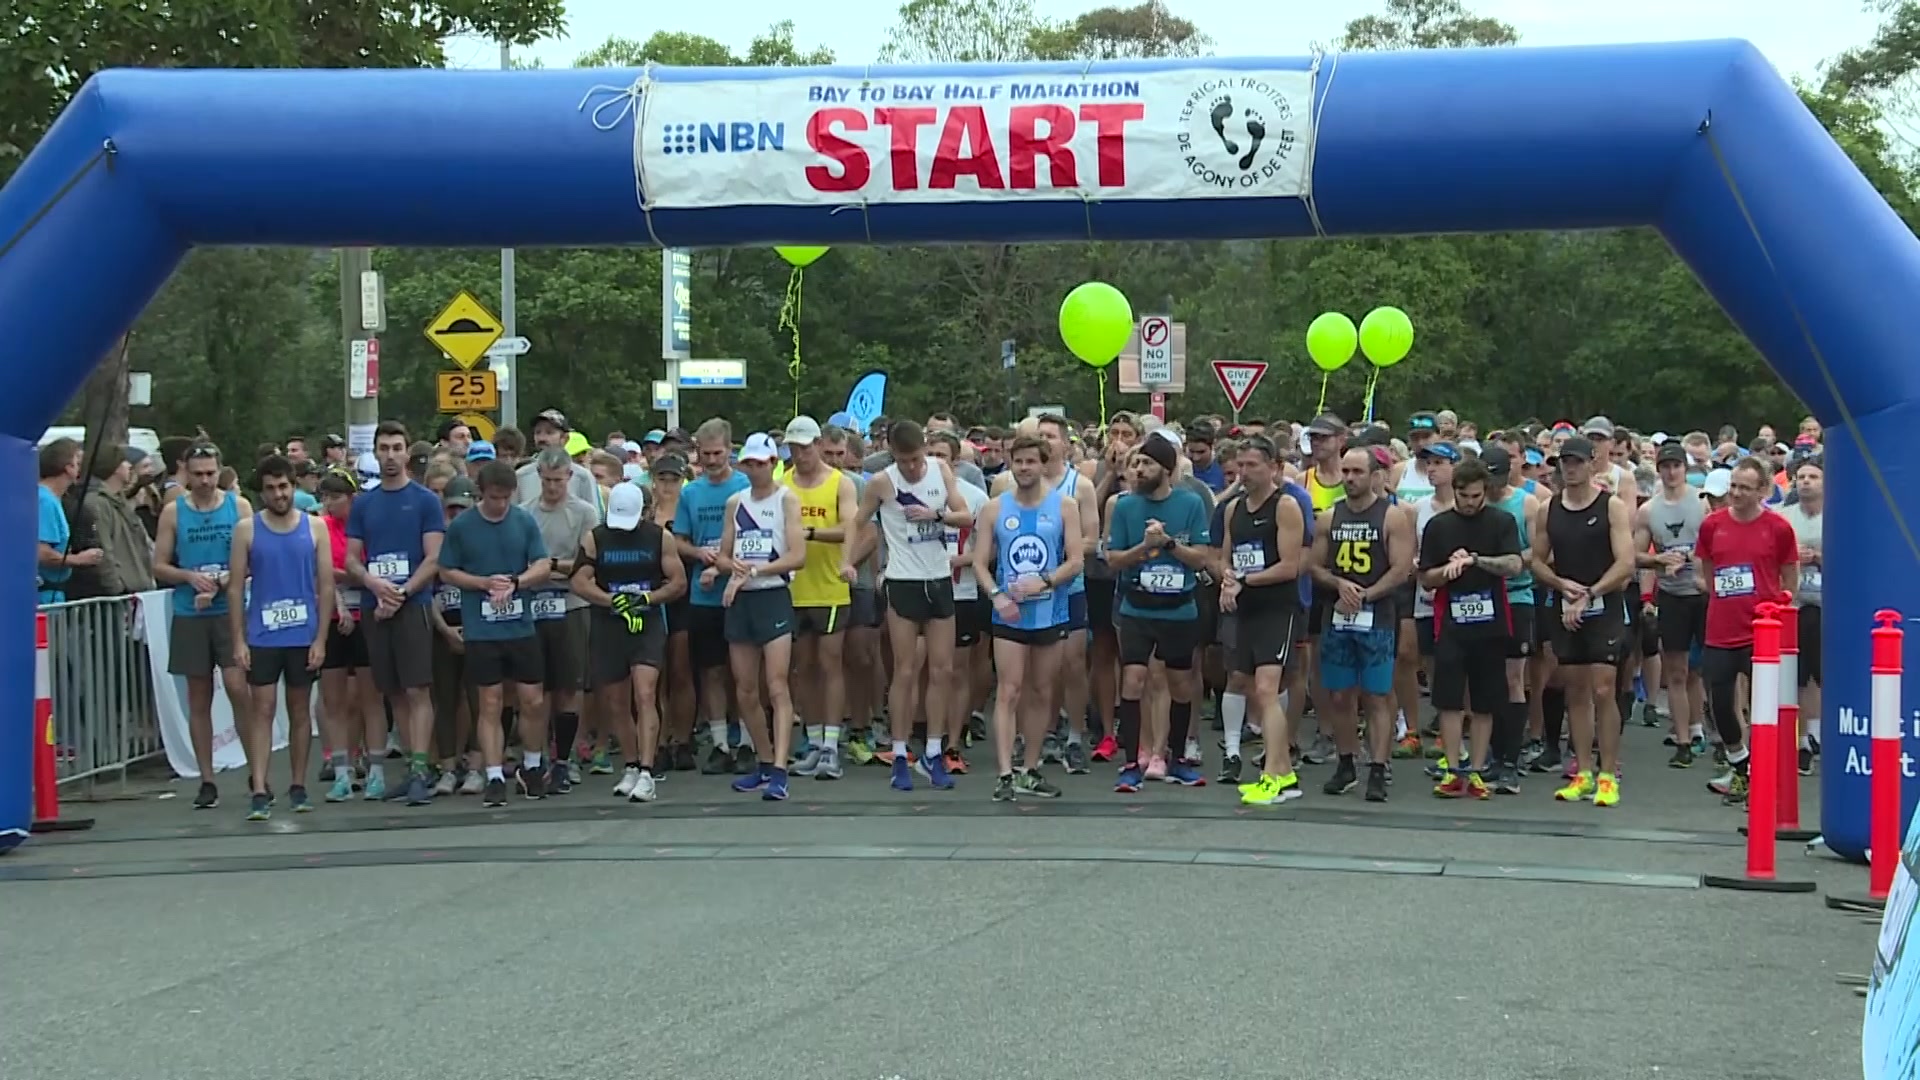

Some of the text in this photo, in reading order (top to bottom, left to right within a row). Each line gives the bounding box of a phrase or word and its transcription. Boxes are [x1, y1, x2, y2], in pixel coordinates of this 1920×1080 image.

[808, 85, 850, 102] BAY
[892, 83, 936, 100] BAY
[944, 83, 1002, 100] HALF
[1010, 81, 1140, 99] MARATHON
[1179, 78, 1293, 122] TERRIGAL TROTTERS
[700, 122, 785, 153] NBN
[805, 103, 1144, 192] START
[1177, 128, 1294, 188] DE AGONY OF DE FEET
[1146, 349, 1164, 359] NO
[1227, 370, 1250, 379] GIVE
[449, 376, 485, 396] 25
[1332, 528, 1379, 541] VENICE CA
[741, 539, 763, 551] 695
[1017, 547, 1040, 560] WIN
[1237, 554, 1256, 567] 590
[1335, 541, 1372, 574] 45
[377, 563, 398, 575] 133
[1150, 574, 1174, 587] 272
[1720, 575, 1743, 589] 258
[534, 600, 557, 612] 665
[1459, 602, 1484, 616] 599
[272, 608, 298, 622] 280
